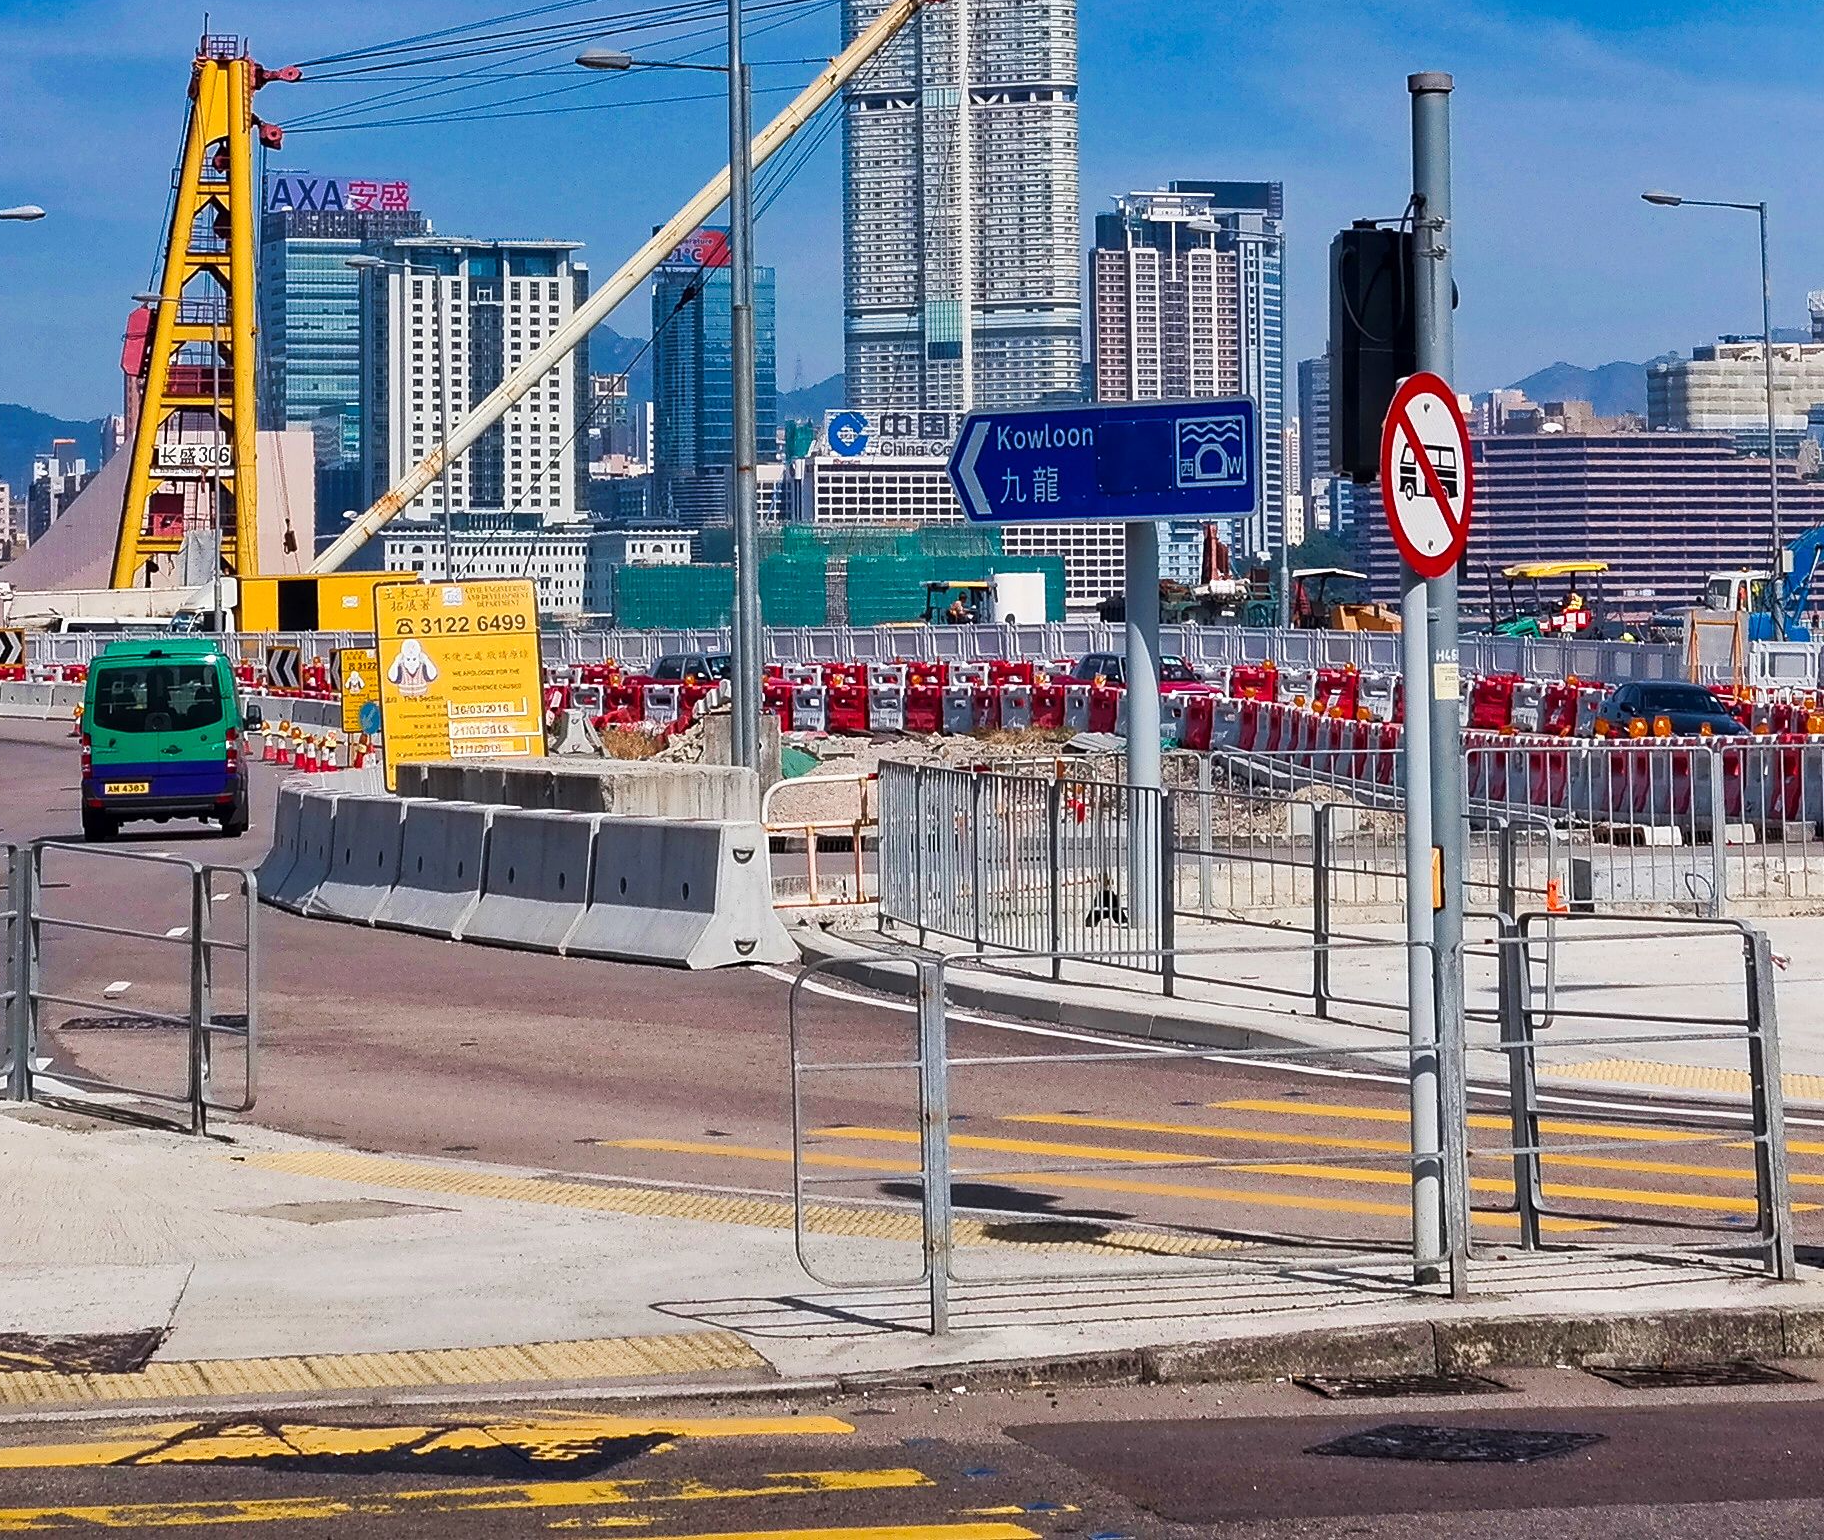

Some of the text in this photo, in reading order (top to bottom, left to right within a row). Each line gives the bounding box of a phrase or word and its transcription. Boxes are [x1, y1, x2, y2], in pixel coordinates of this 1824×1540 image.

[270, 179, 344, 211] AXA
[349, 181, 410, 212] 安盛
[880, 441, 925, 456] China
[997, 426, 1094, 451] Kowloon
[1180, 459, 1194, 477] 西
[1227, 456, 1242, 475] W
[1000, 466, 1061, 504] 九龍
[420, 614, 527, 634] 3122 6499
